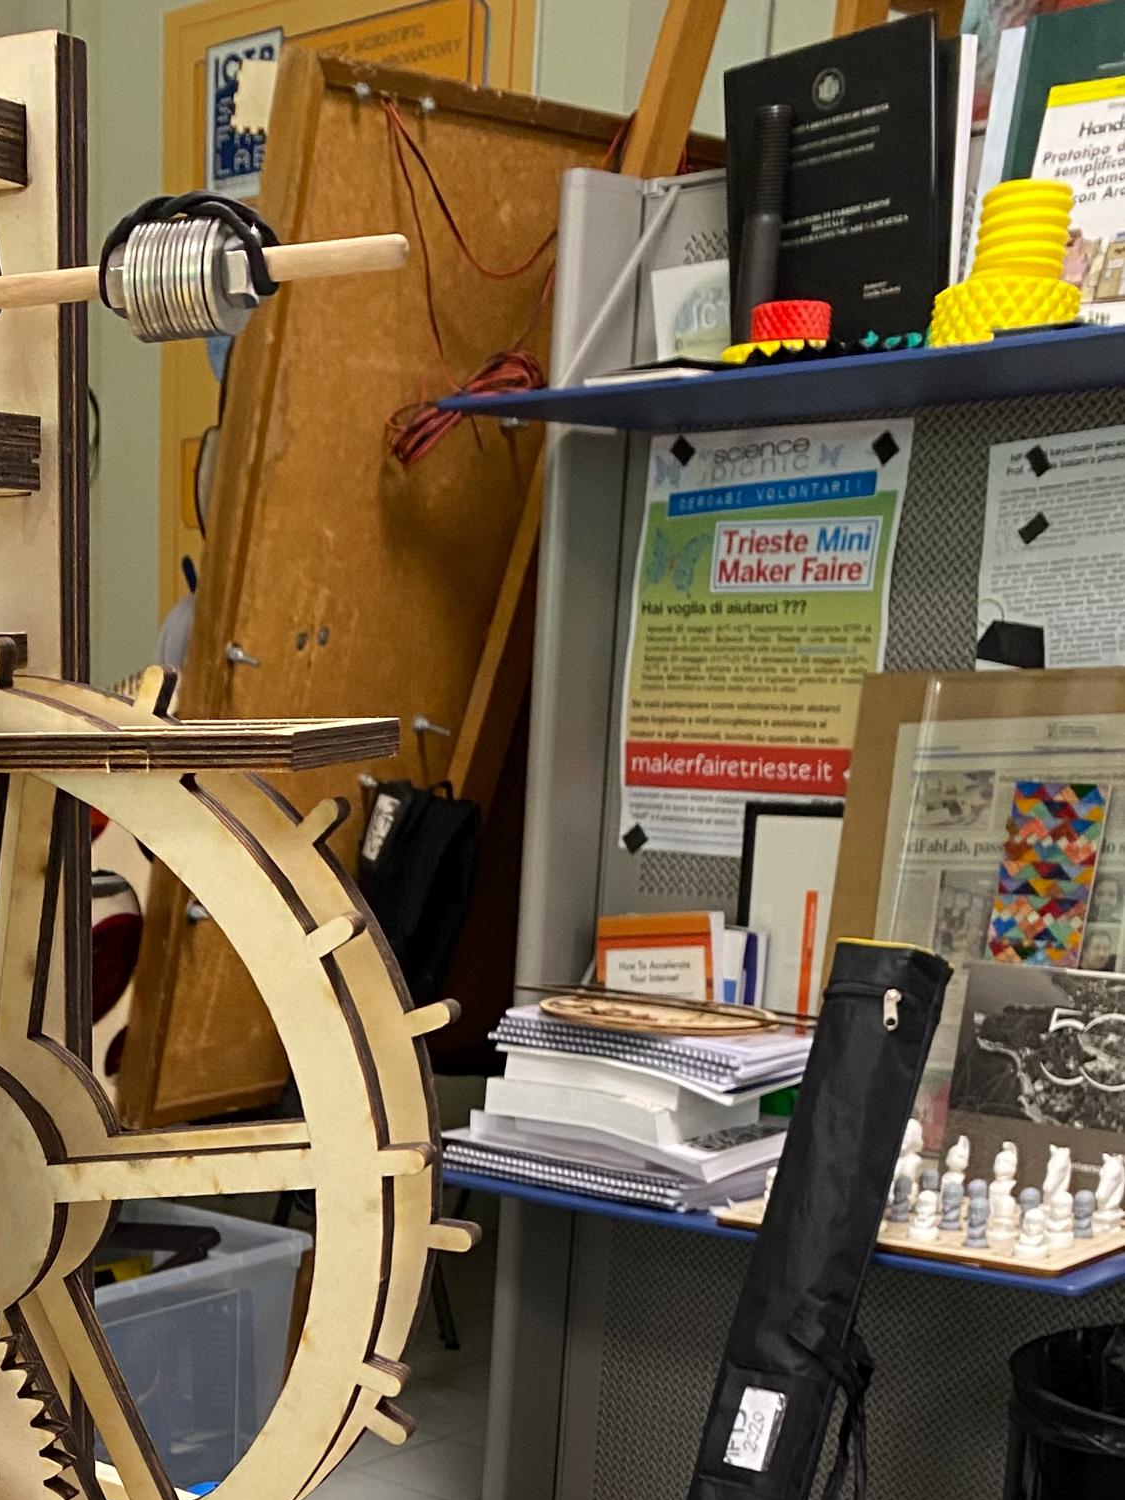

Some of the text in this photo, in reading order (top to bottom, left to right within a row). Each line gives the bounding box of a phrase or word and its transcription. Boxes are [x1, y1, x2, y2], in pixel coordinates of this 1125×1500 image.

[1078, 112, 1125, 137] Hand
[1042, 143, 1111, 166] Prototipo
[1054, 156, 1125, 177] semplifica
[714, 437, 811, 465] science
[710, 454, 810, 483] picnic
[723, 525, 872, 555] Trieste Mini
[717, 555, 863, 584] Maker Faire
[641, 599, 808, 617] Hai voglia di aiutarci ???
[632, 752, 833, 782] makerfairetrieste.it
[638, 960, 647, 970] To
[649, 959, 691, 969] Accelerate
[649, 972, 680, 982] Internet
